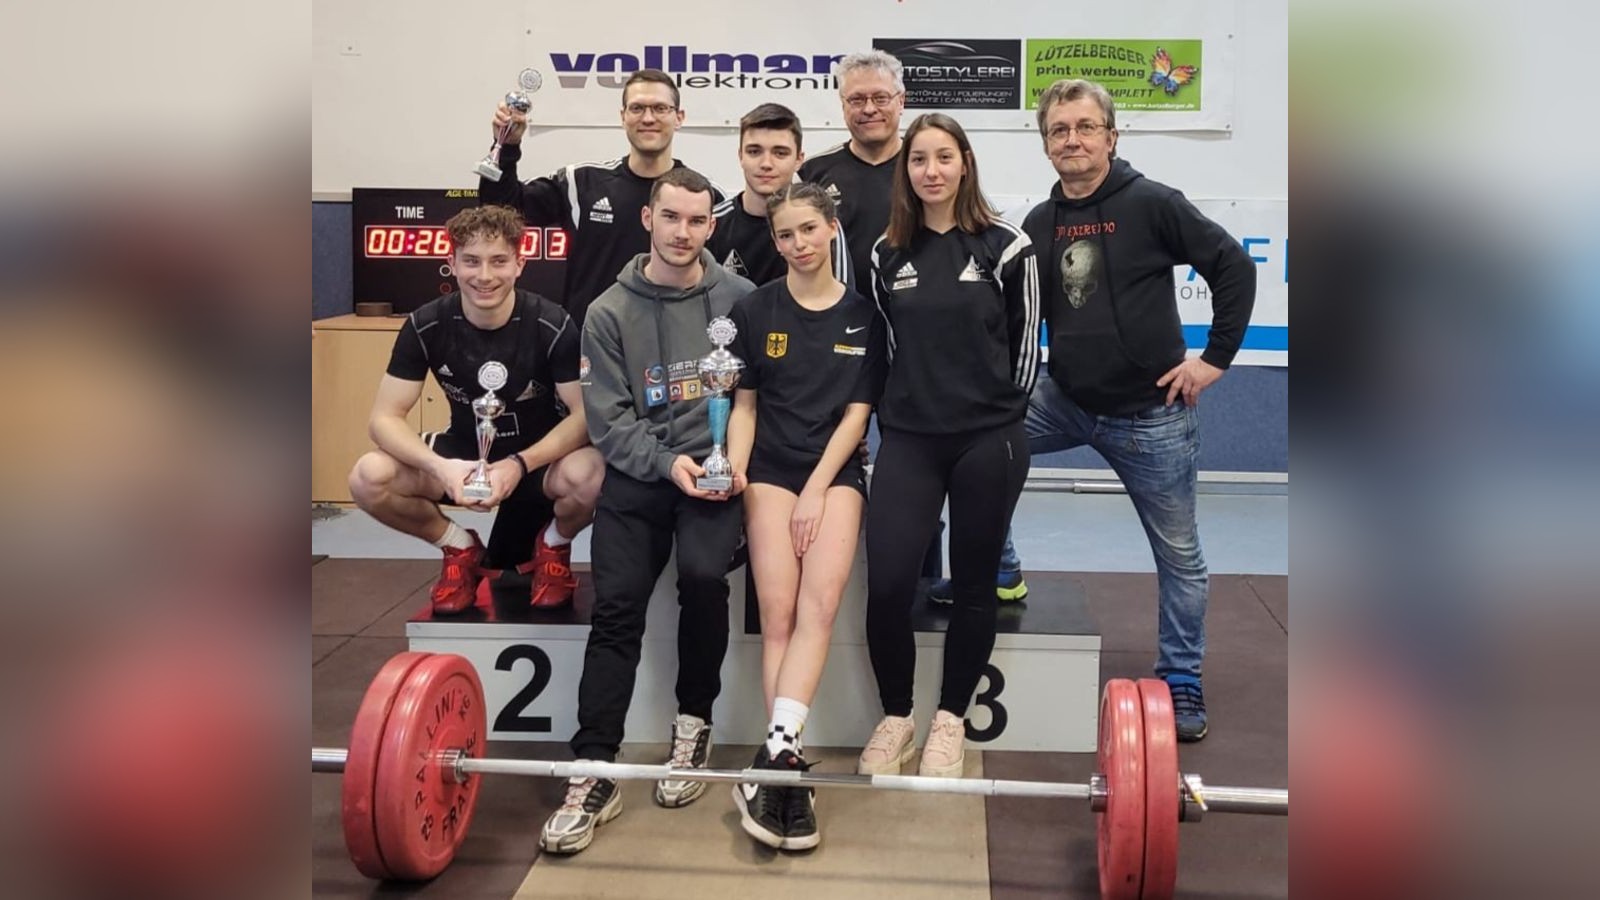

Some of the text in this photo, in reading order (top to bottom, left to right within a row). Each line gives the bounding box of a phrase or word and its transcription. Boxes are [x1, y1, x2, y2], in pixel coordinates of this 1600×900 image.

[901, 65, 1016, 78] TOSTYLEREI
[1036, 65, 1072, 77] print
[1080, 66, 1146, 79] werbung
[676, 73, 839, 90] lektroni
[1107, 88, 1155, 98] MPLETT
[395, 206, 425, 219] TIME
[368, 229, 451, 255] 00:26
[549, 232, 566, 256] 3
[492, 643, 553, 733] 2
[964, 663, 1008, 743] 3
